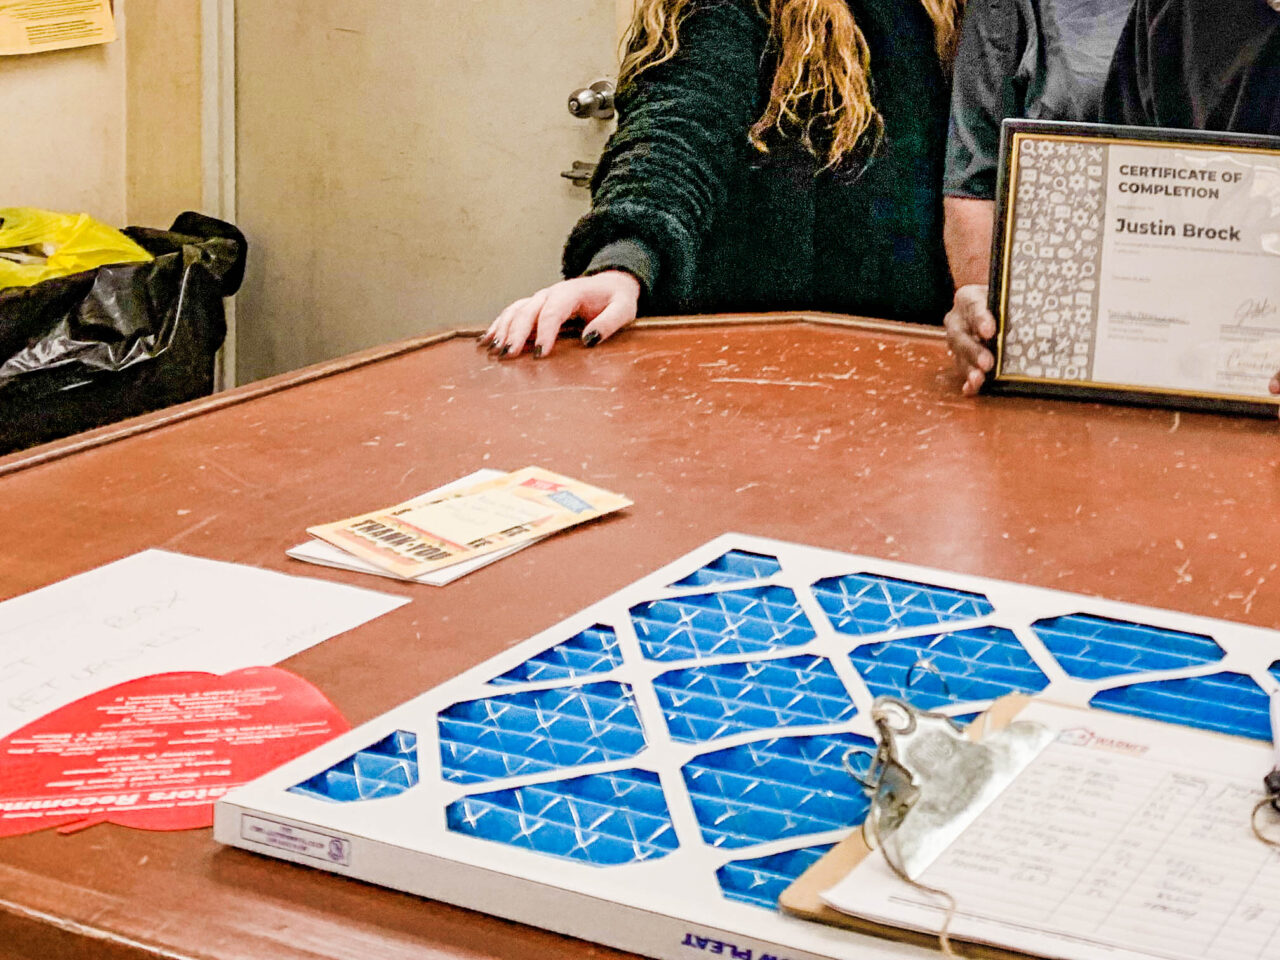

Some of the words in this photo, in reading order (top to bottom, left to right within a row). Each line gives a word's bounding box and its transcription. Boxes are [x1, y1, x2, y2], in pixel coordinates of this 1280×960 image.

[1119, 165, 1217, 182] CERTIFICATE
[1221, 171, 1243, 184] OF
[1118, 182, 1220, 200] COMPLETION
[1115, 218, 1177, 237] Justin
[1182, 223, 1241, 242] Brock
[0, 794, 139, 811] Recomm
[146, 787, 230, 801] ators
[681, 932, 753, 960] PLEAT
